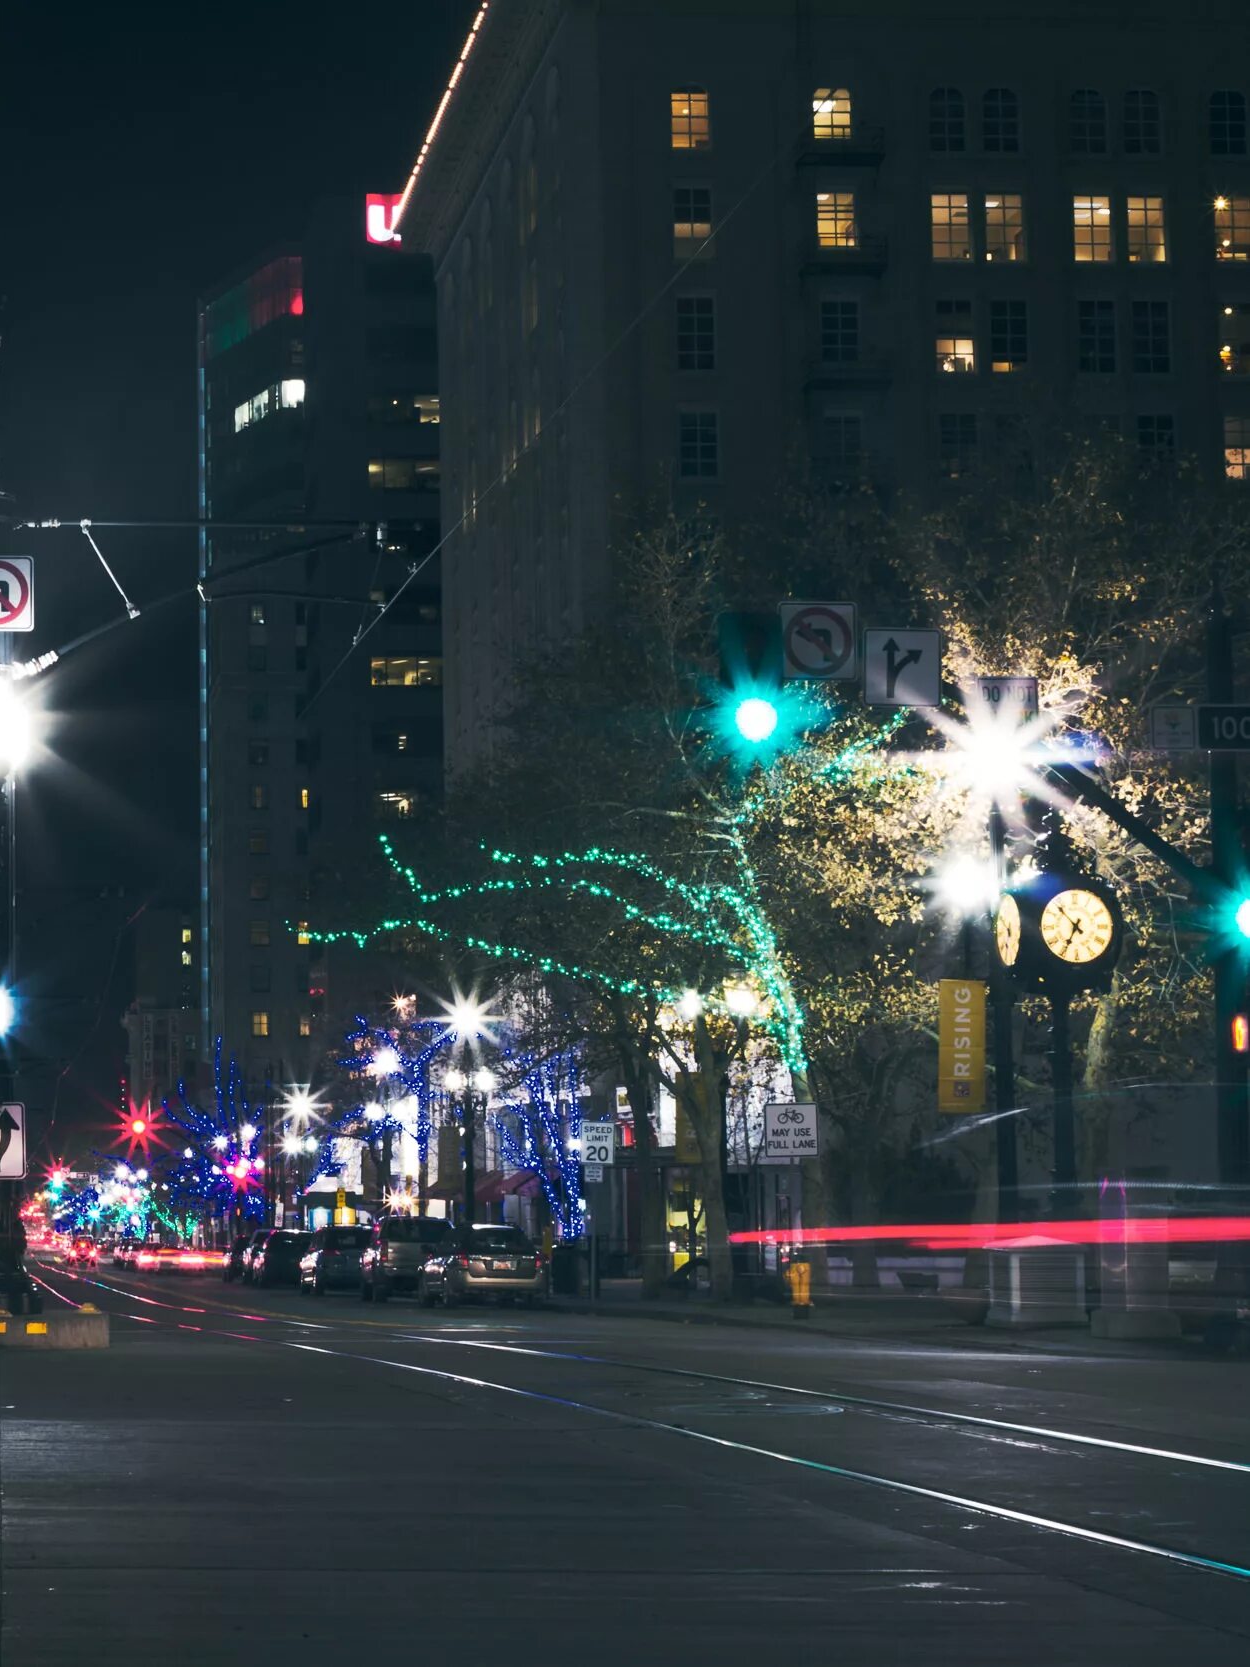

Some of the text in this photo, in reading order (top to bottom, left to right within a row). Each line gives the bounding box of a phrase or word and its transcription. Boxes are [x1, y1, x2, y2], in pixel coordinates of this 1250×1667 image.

[982, 685, 1033, 703] DO NOT
[954, 987, 971, 1077] RISING
[584, 1125, 612, 1134] SPEED
[772, 1128, 811, 1137] MAY USE
[768, 1140, 816, 1149] FULL LANE
[586, 1146, 608, 1162] 20
